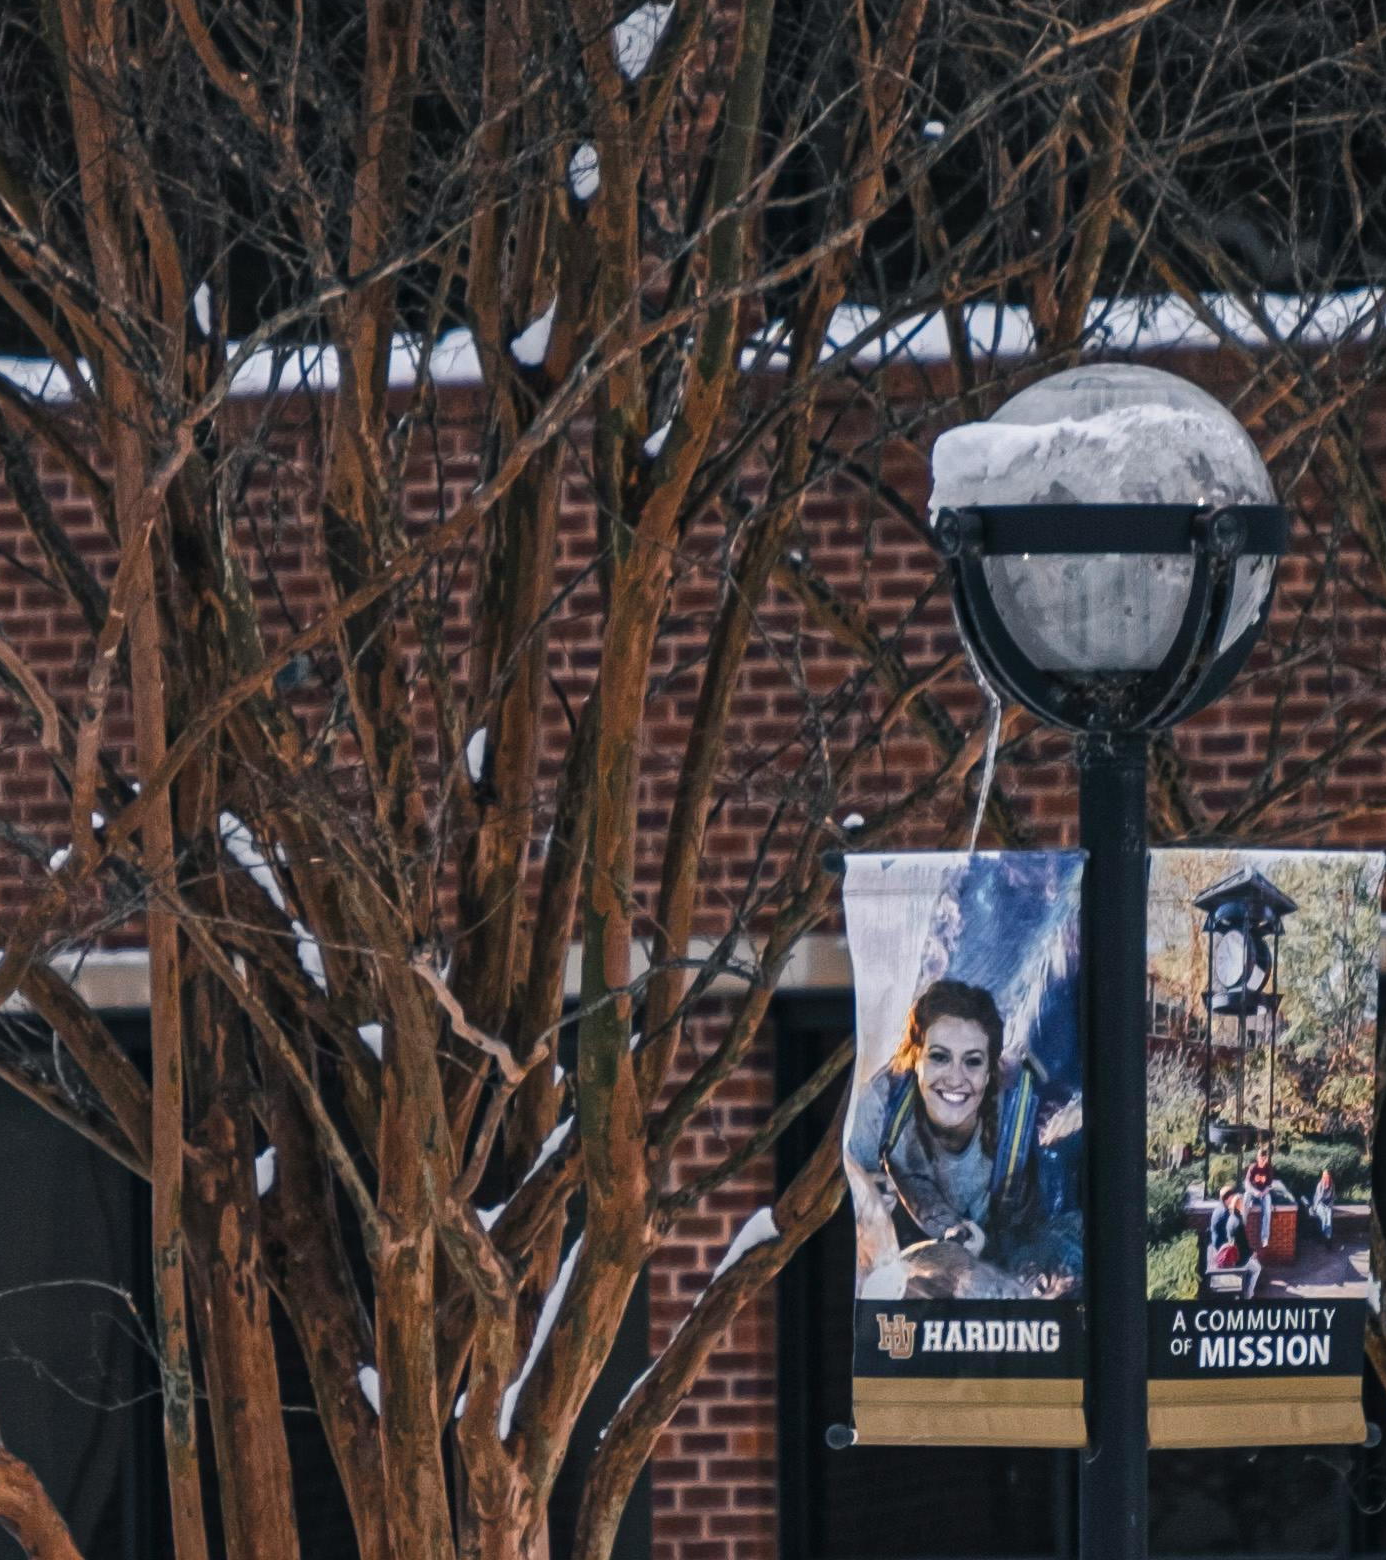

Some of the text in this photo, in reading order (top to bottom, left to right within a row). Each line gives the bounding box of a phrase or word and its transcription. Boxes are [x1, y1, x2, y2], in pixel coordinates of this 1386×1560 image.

[922, 1319, 1060, 1352] HARDING
[1172, 1307, 1336, 1333] A COMMUNITY
[1170, 1334, 1331, 1368] OF MISSION
